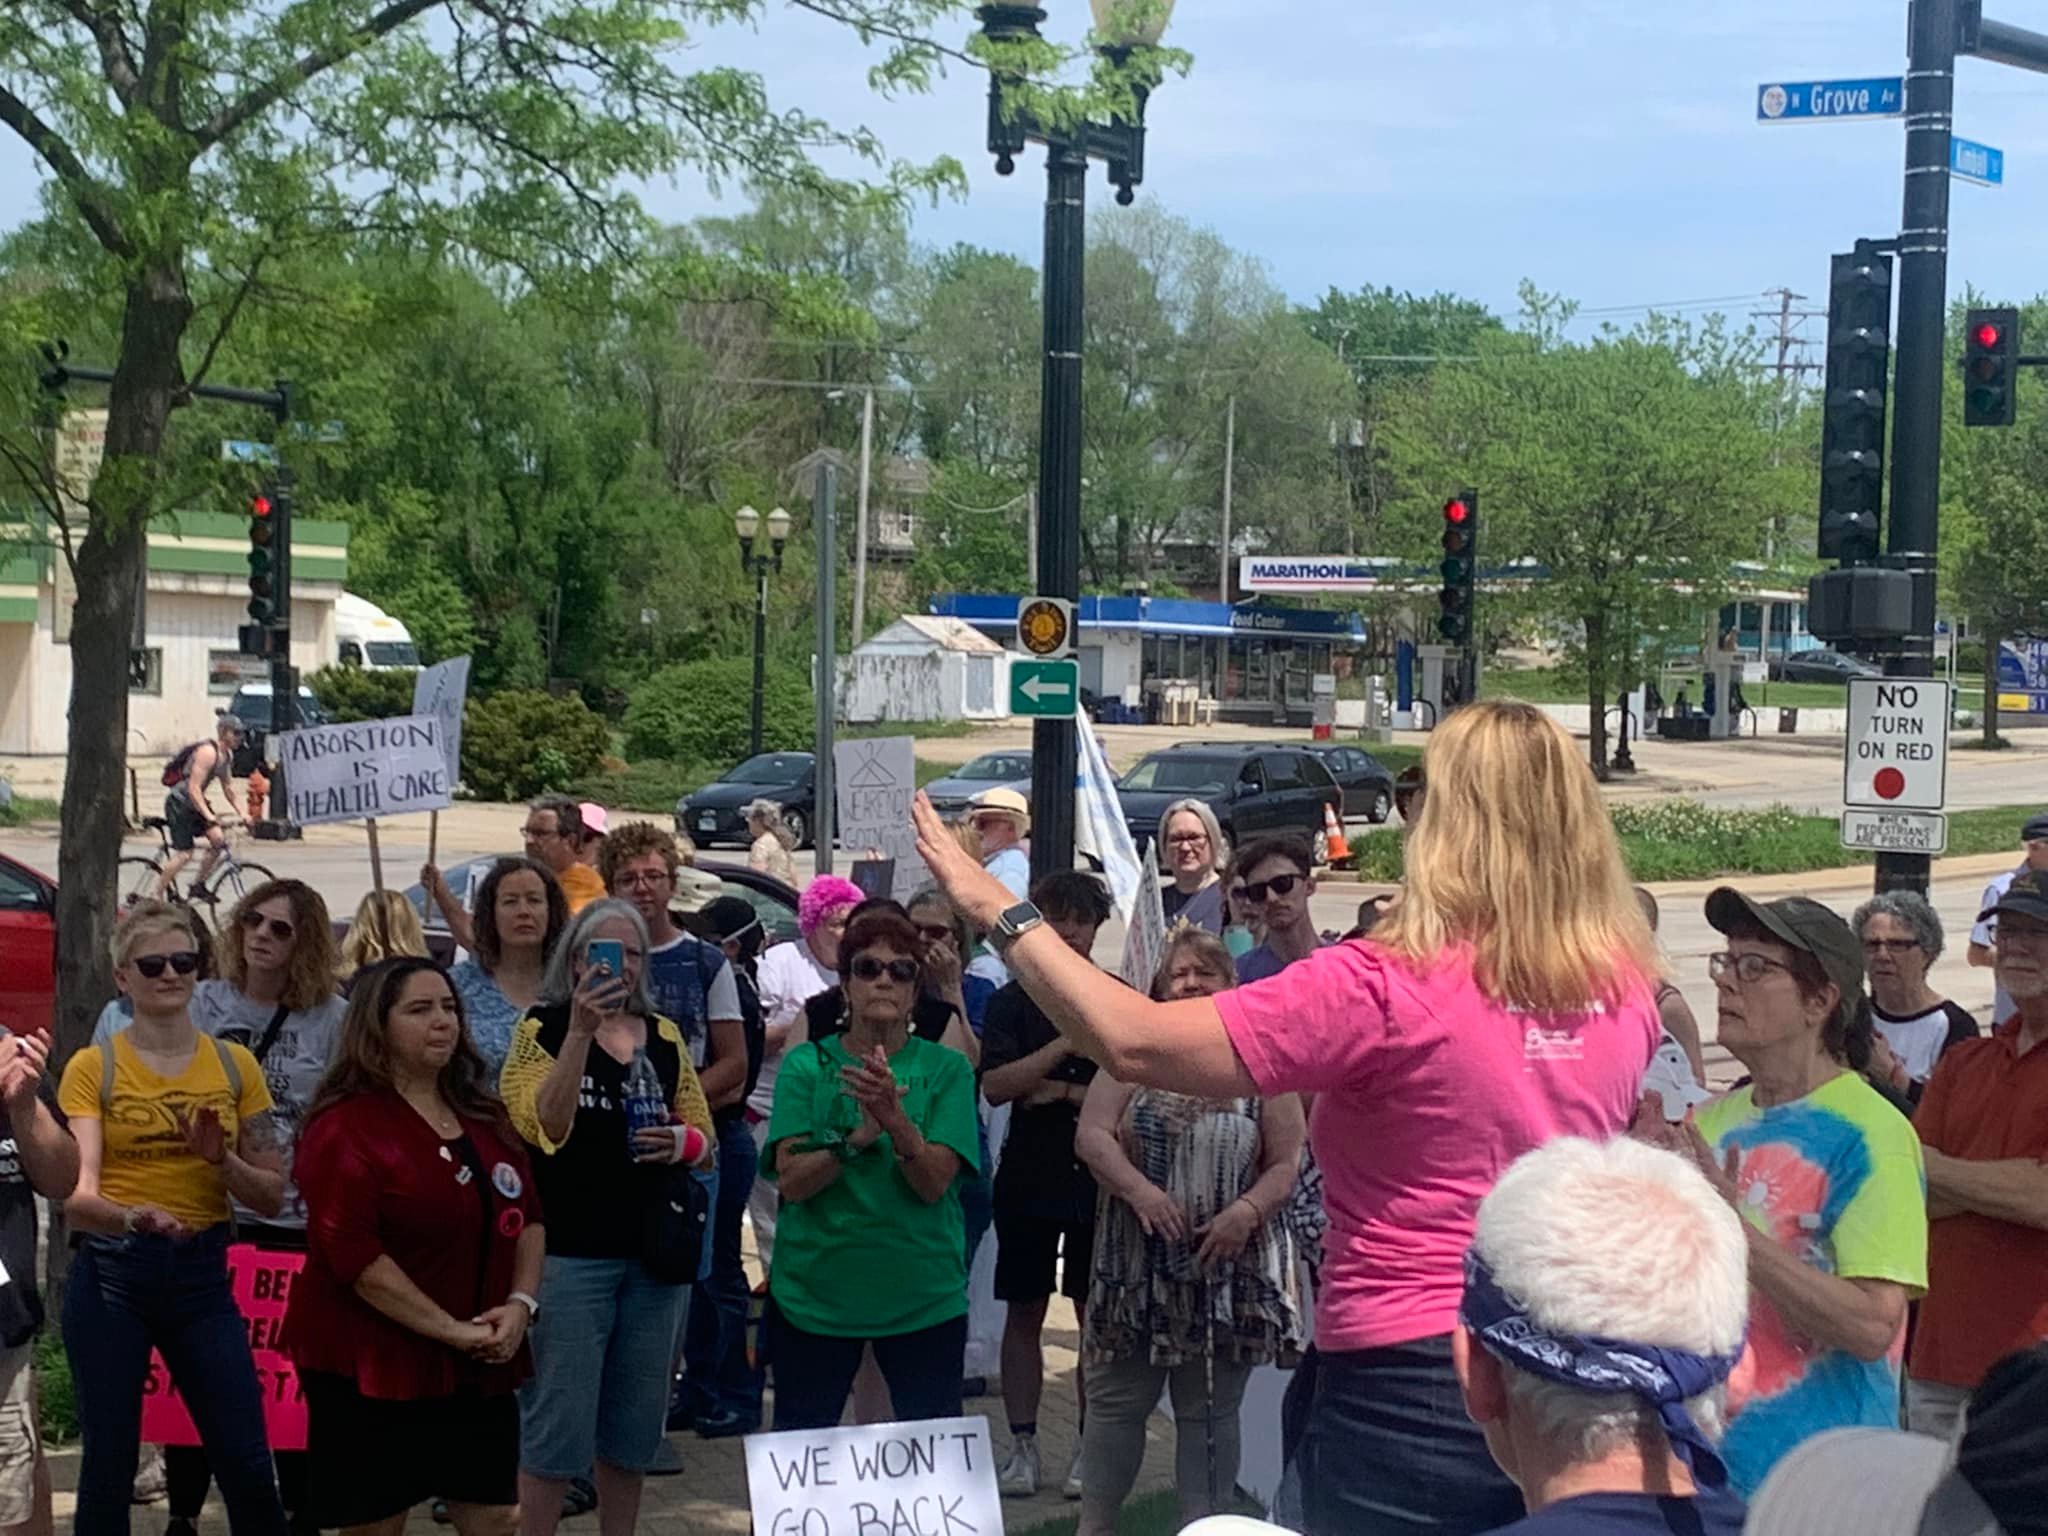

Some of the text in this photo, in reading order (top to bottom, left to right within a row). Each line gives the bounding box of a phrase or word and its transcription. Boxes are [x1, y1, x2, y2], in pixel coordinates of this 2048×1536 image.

[1810, 84, 1869, 115] Grove
[1251, 564, 1343, 578] MARATHON
[1876, 685, 1918, 708] NO
[1871, 716, 1923, 734] TURN
[292, 721, 434, 761] ABORTION
[1858, 741, 1934, 760] ON RED
[353, 758, 379, 777] IS
[294, 769, 447, 820] HEALTH CARE
[1856, 823, 1933, 837] PEDESTRIANS
[1878, 816, 1909, 825] WHEN
[1855, 834, 1930, 848] ARE PRESENT
[769, 1433, 978, 1491] WE WON'T
[771, 1495, 978, 1536] GO BACK
